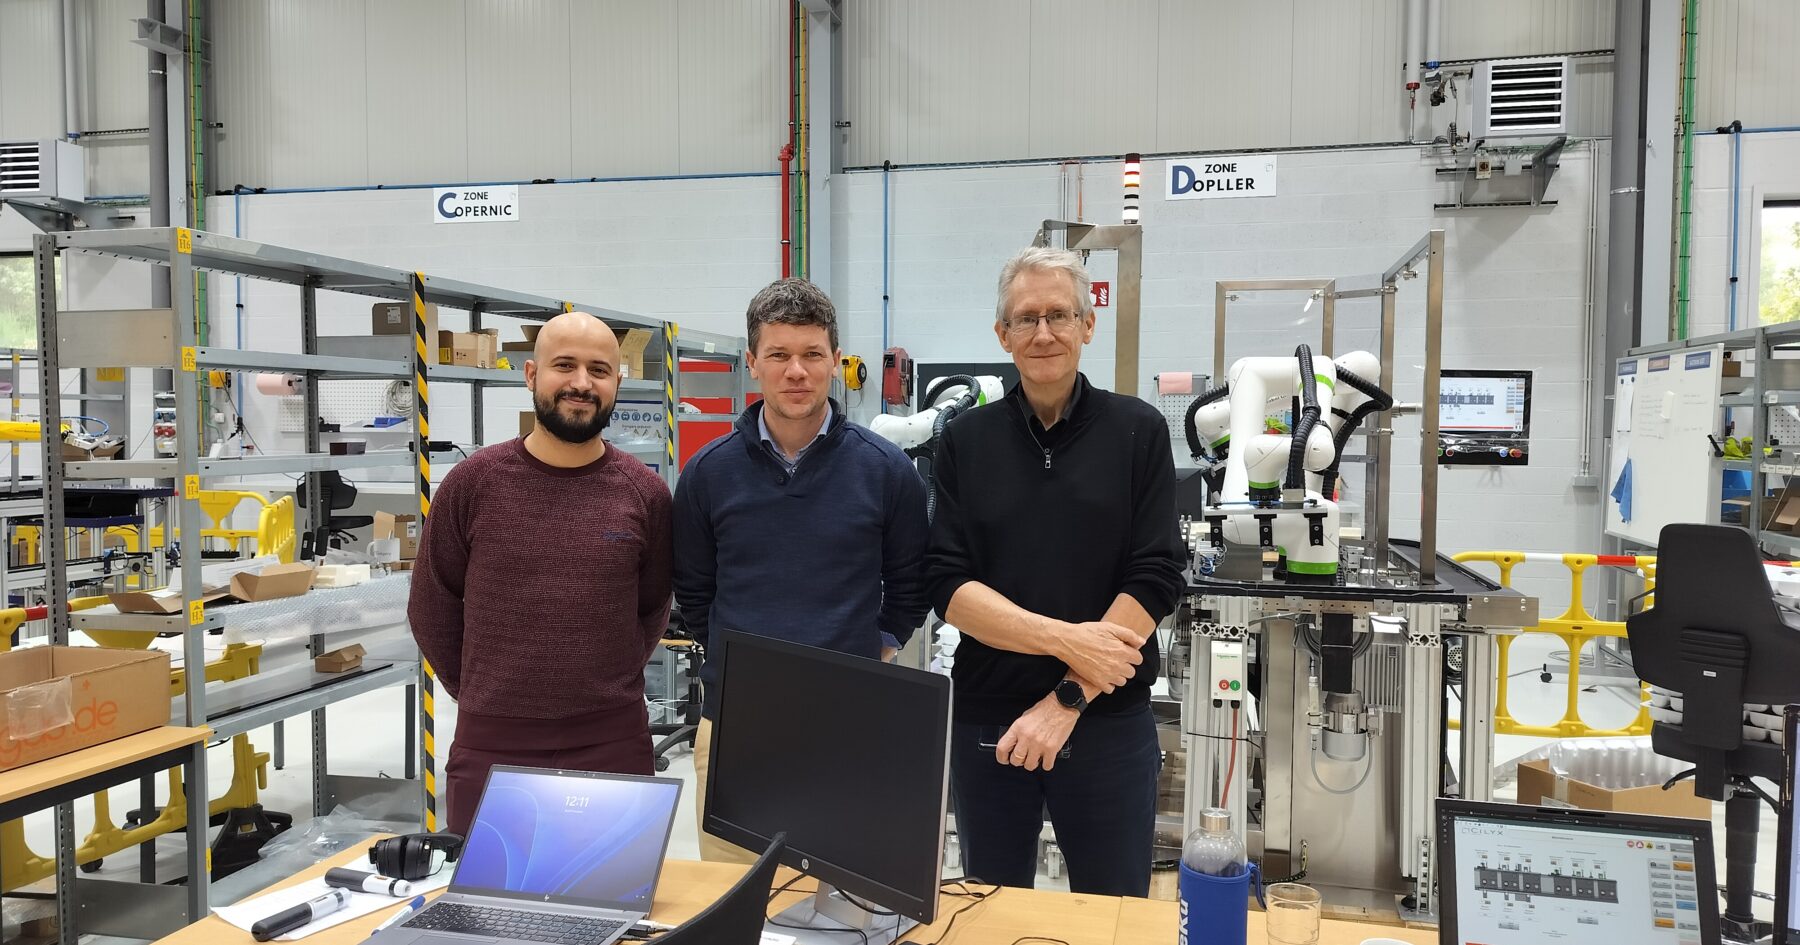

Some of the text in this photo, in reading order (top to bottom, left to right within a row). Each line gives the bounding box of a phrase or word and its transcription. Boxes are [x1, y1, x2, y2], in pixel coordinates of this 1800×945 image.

[1205, 163, 1237, 174] ZONE
[1172, 165, 1255, 195] DOPLLER
[464, 191, 489, 201] ZONE
[438, 192, 512, 219] COPERNIC
[565, 795, 590, 808] 12:11
